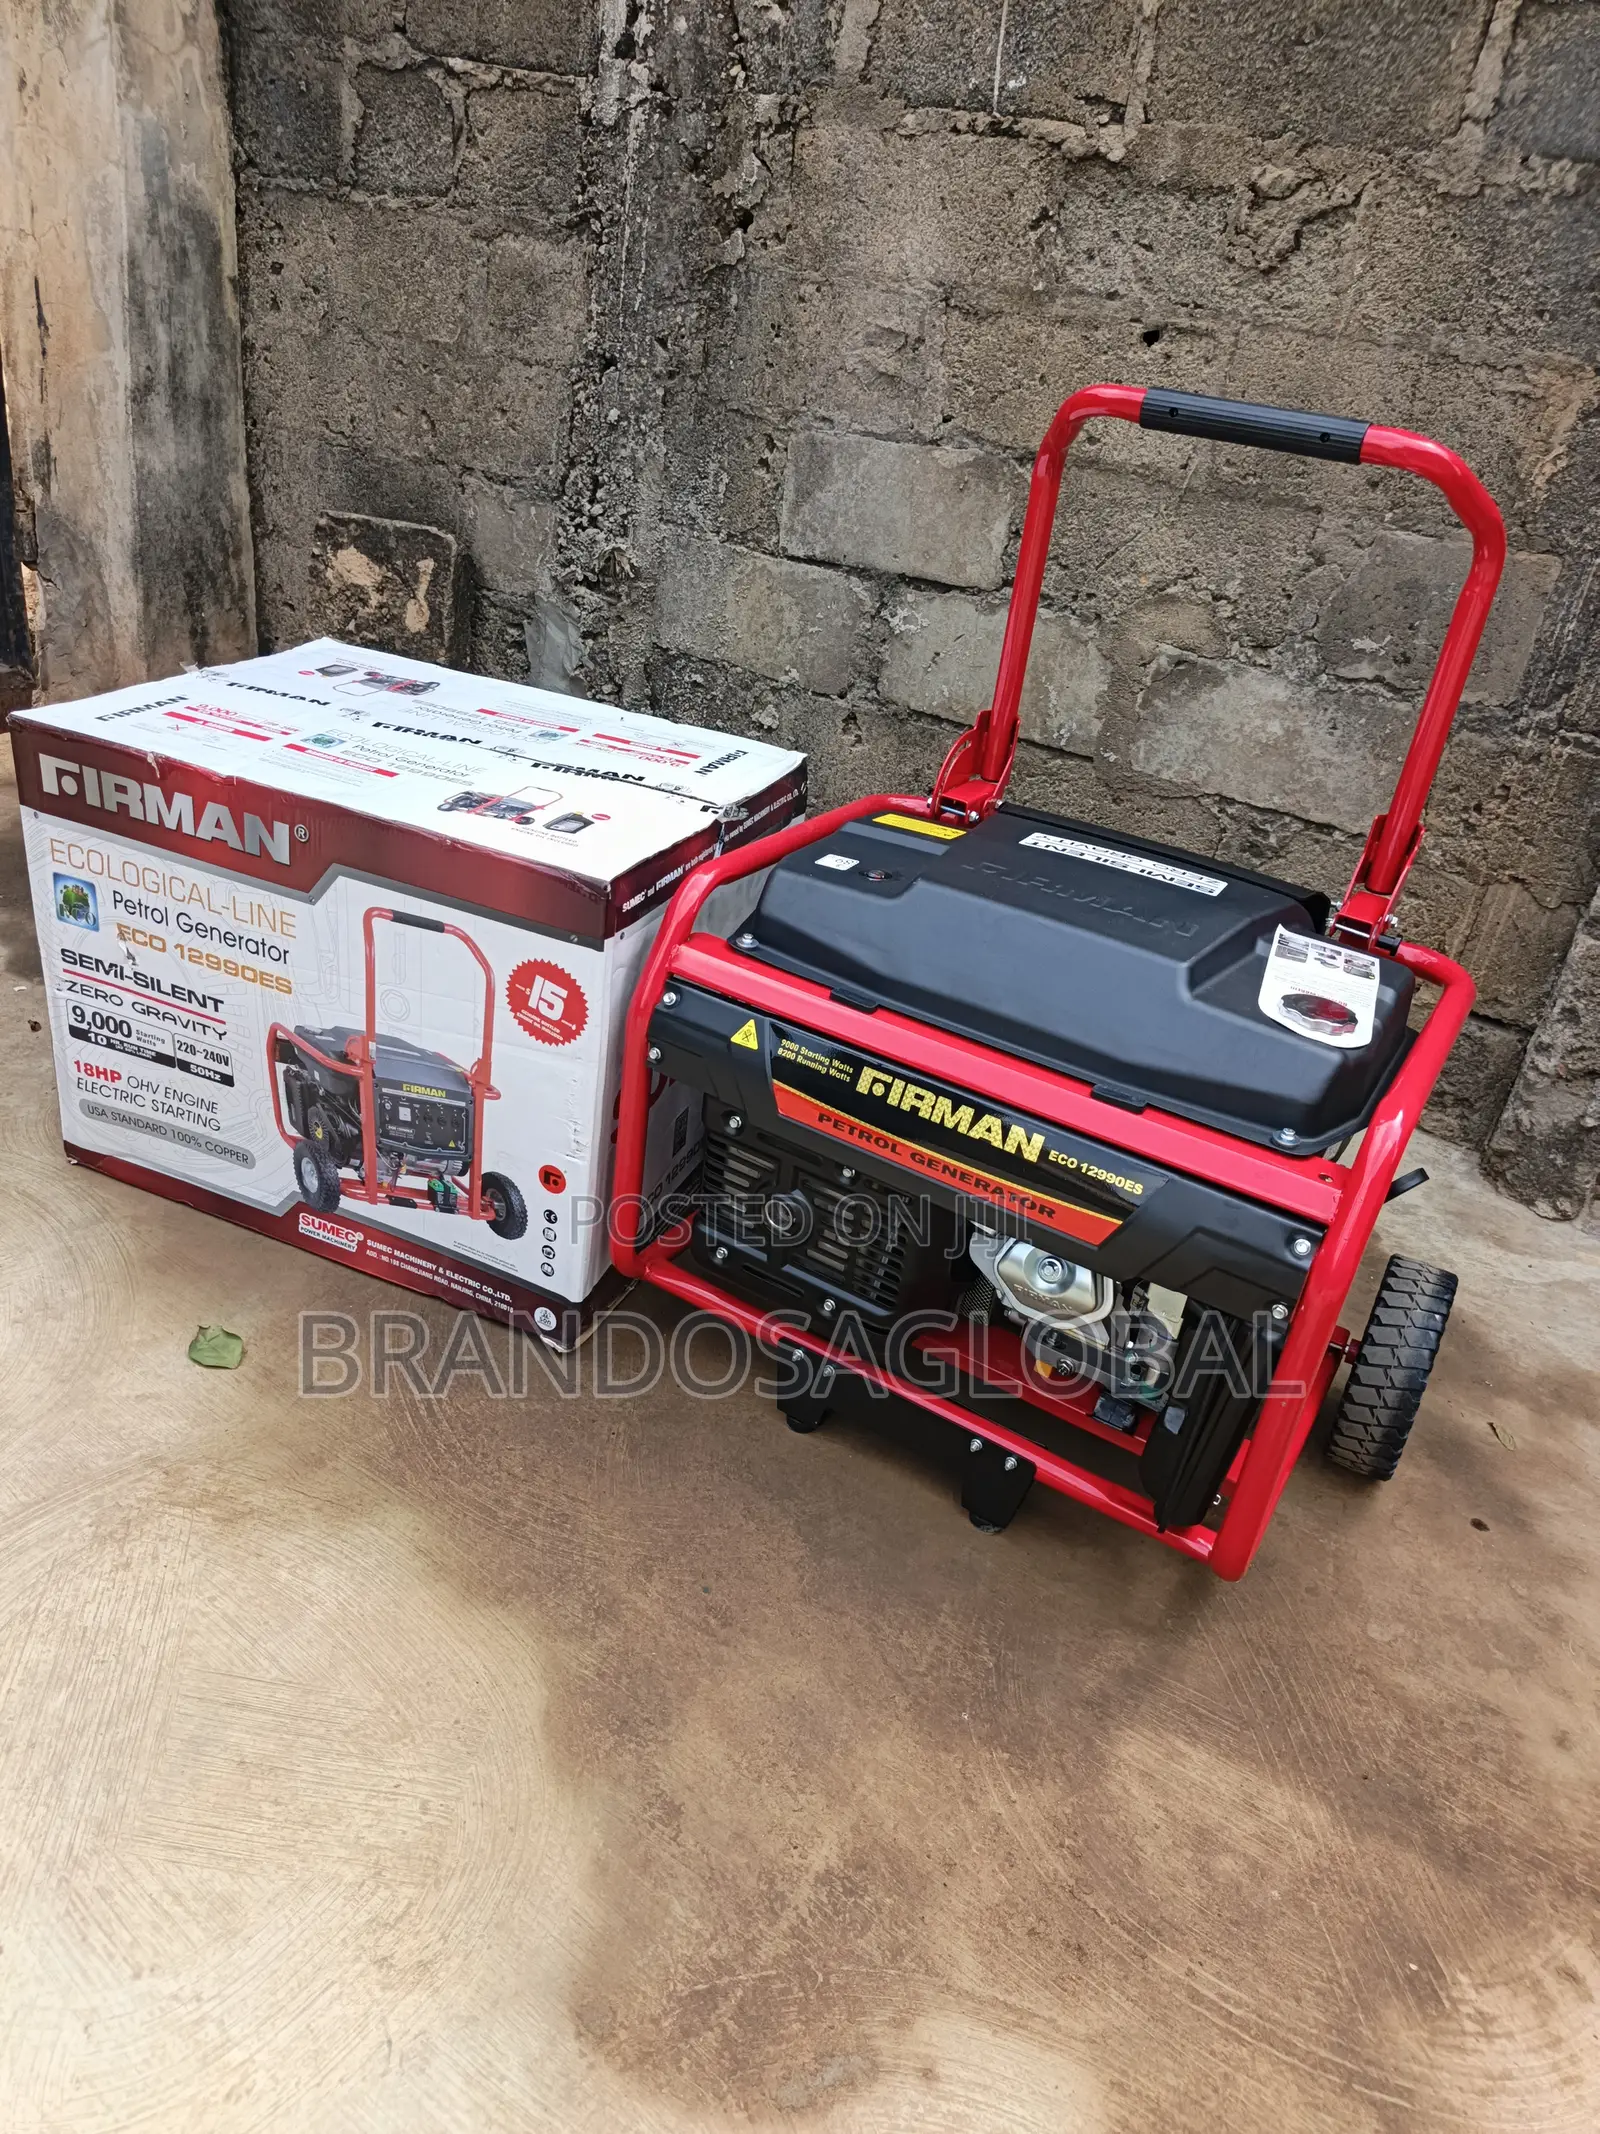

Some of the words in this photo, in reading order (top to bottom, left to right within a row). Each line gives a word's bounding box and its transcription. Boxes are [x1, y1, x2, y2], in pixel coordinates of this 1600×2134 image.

[95, 694, 189, 722] FIRMAN
[226, 682, 331, 706] FIRMAN
[371, 722, 483, 745] FIRMAN
[352, 744, 394, 758] Petrol
[395, 756, 471, 778] Generator
[694, 749, 750, 777] FIRMAN
[49, 837, 298, 940] ECOLOGICAL-LINE
[112, 889, 170, 926] Petrol
[176, 912, 290, 965] Generator
[116, 922, 167, 953] ECO
[173, 943, 292, 995] 12990ES
[60, 947, 225, 1013] SEMI-SILENT
[65, 979, 124, 1007] ZERO
[131, 1001, 228, 1041] GRAVITY
[72, 1005, 132, 1039] 9,000
[135, 1029, 165, 1044] Starting
[88, 1032, 108, 1046] 10
[136, 1036, 157, 1047] Watts
[780, 1038, 799, 1052] 9000
[800, 1046, 830, 1066] Starting
[832, 1058, 854, 1075] Watts
[190, 1063, 222, 1082] 50Hz
[777, 1047, 796, 1060] 8200
[797, 1054, 827, 1075] Running
[829, 1066, 851, 1083] Watts
[74, 1059, 123, 1083] 18HP
[127, 1075, 160, 1095] OHV
[164, 1086, 219, 1115] ENGINE
[77, 1077, 146, 1108] ELECTRIC
[151, 1100, 221, 1132] STARTING
[402, 1083, 446, 1098] FIRMAN
[87, 1104, 109, 1119] USA
[111, 1111, 168, 1136] STANDARD
[171, 1129, 202, 1148] 100%
[204, 1142, 250, 1165] COPPER
[856, 1065, 1046, 1163] FIRMAN
[1048, 1149, 1078, 1169] ECO
[1080, 1160, 1144, 1196] 12990ES
[817, 1111, 902, 1156] PETROL
[909, 1151, 1057, 1220] GENERATOR
[300, 1226, 321, 1238] POWER
[321, 1234, 356, 1250] MACHINERY
[366, 1239, 393, 1255] SUMEC
[394, 1249, 438, 1272] MACHINERY
[438, 1266, 445, 1274] &
[445, 1270, 481, 1290] ELECTRIC
